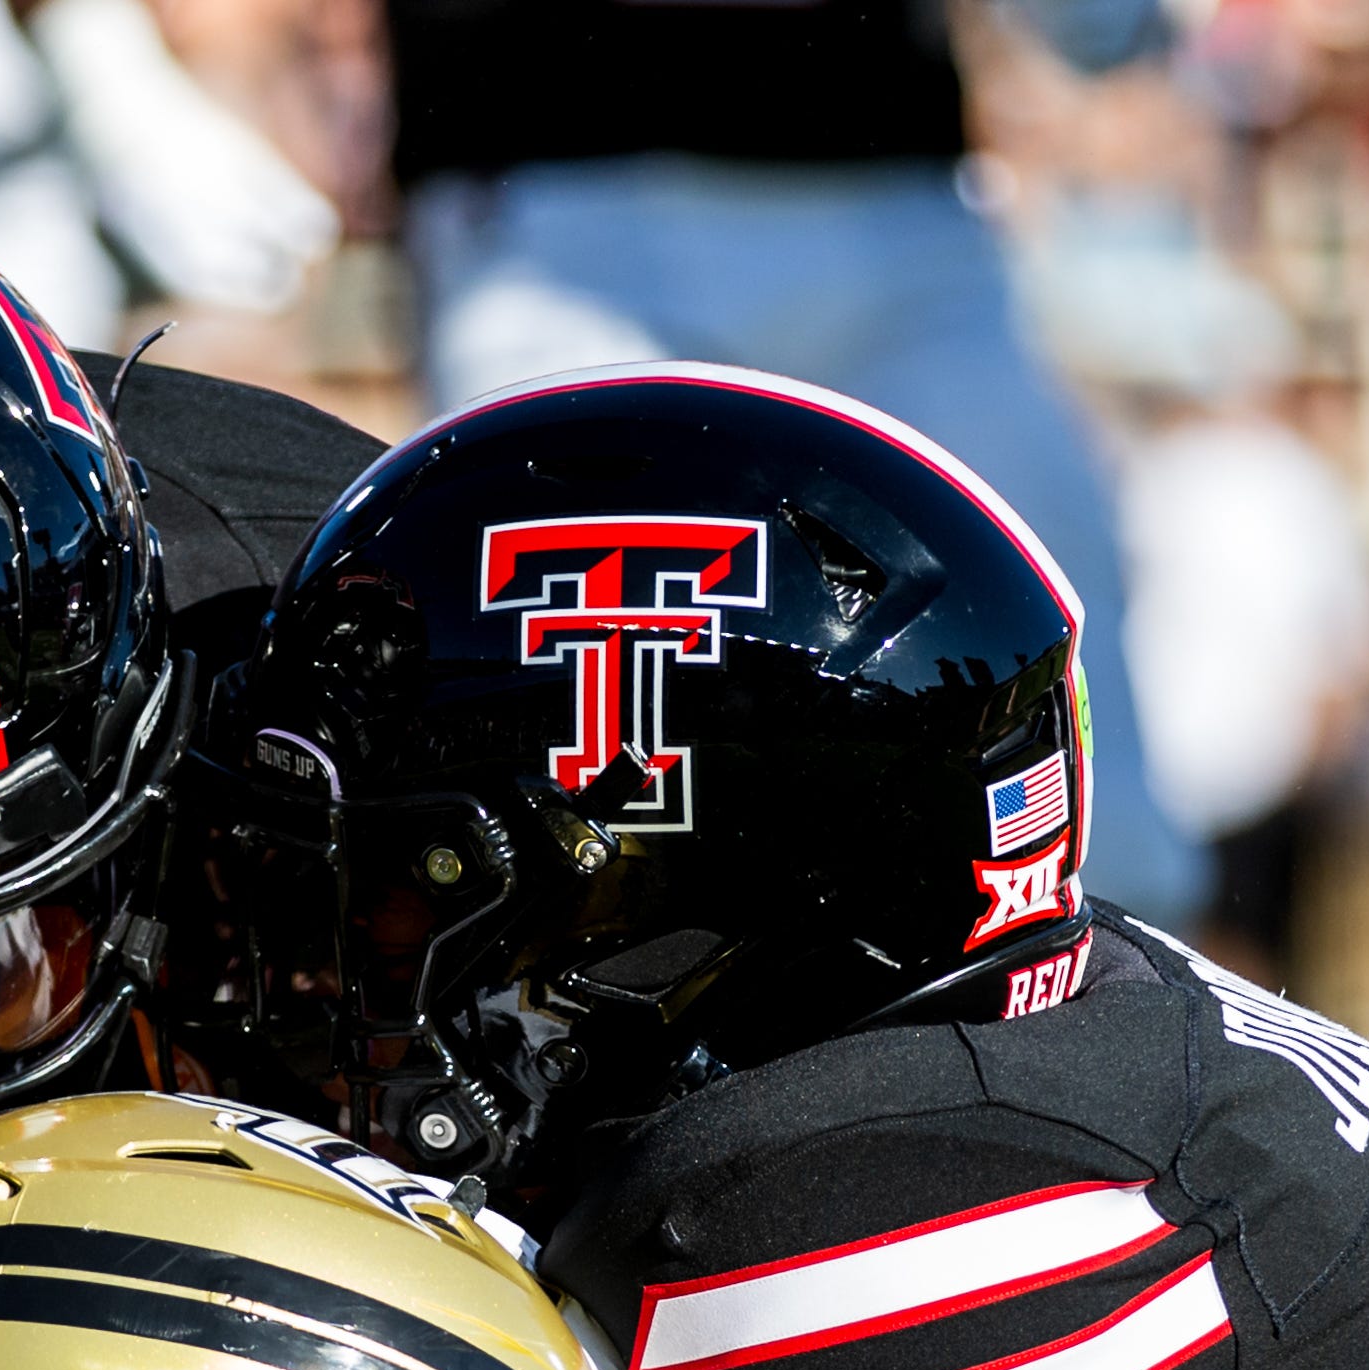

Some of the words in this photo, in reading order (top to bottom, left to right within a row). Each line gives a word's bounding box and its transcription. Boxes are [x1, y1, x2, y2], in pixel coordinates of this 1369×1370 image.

[257, 739, 291, 772] GUNS
[295, 755, 315, 779] UP
[1003, 952, 1072, 1020] RED
